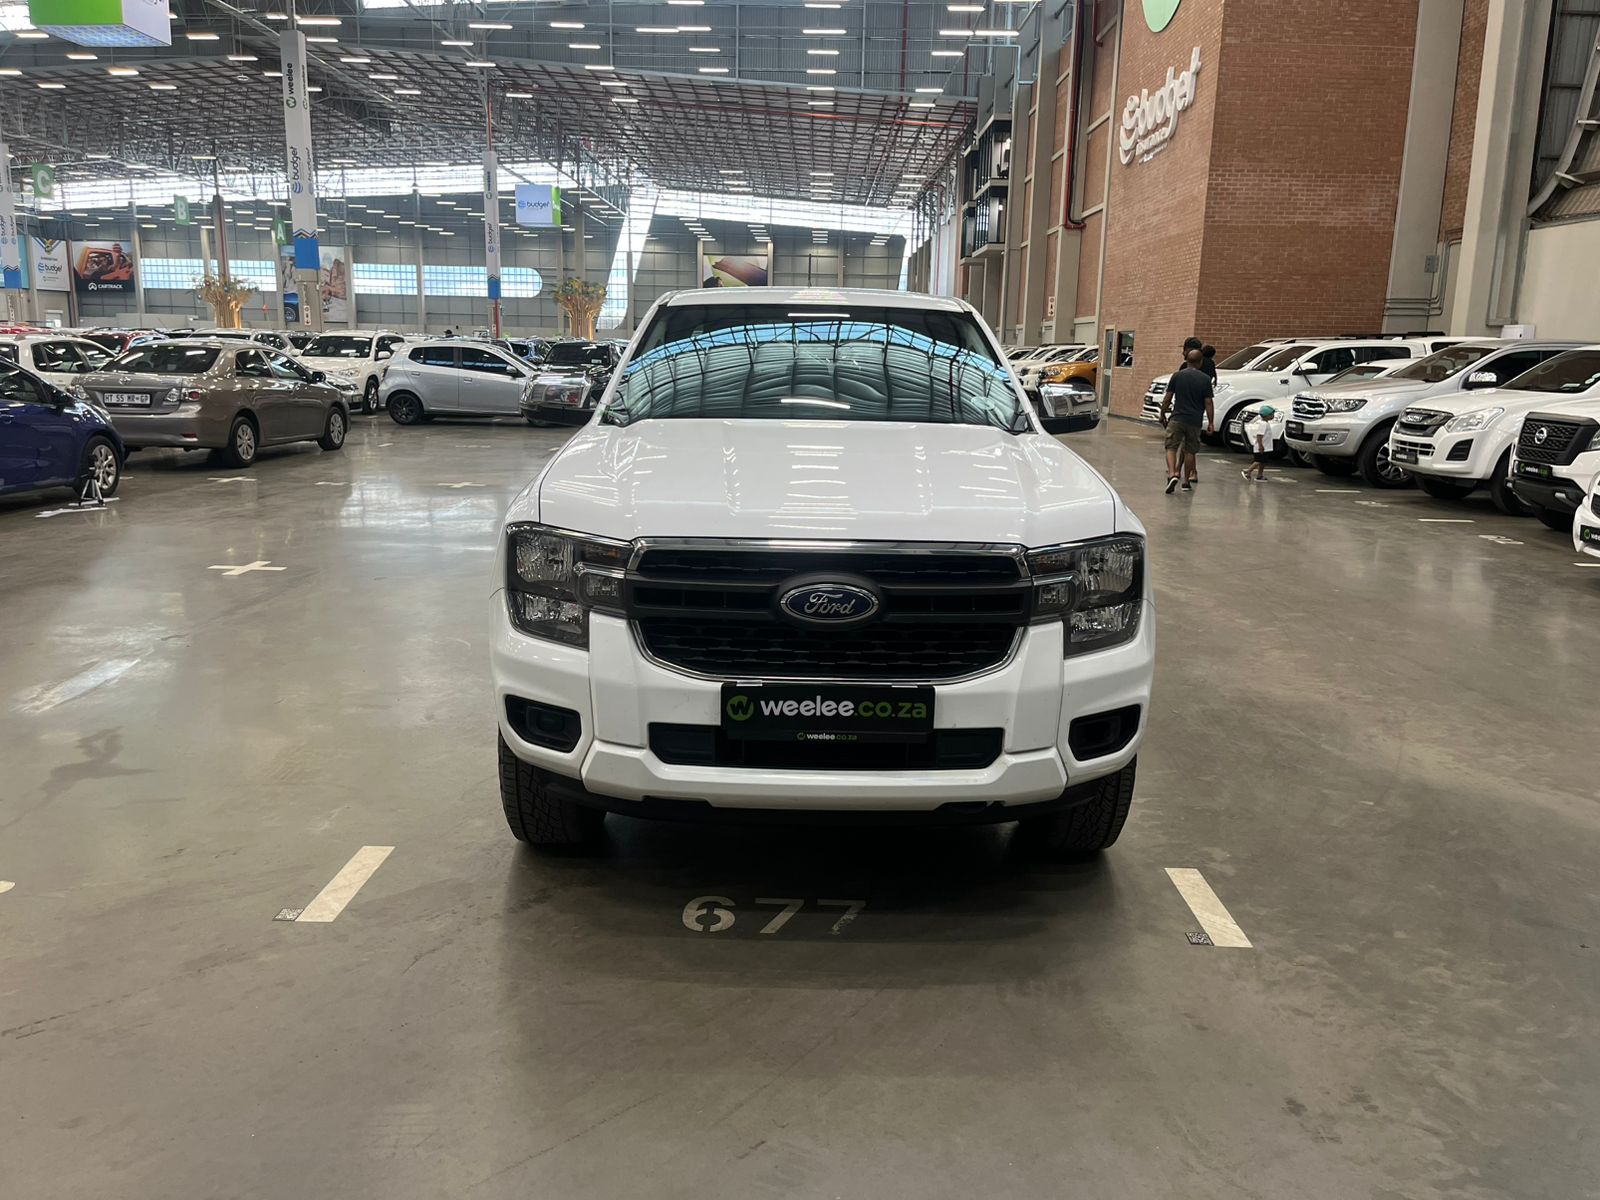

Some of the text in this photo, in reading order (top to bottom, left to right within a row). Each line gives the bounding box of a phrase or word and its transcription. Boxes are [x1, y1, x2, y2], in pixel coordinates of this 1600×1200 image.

[286, 62, 295, 95] weelee
[1138, 46, 1201, 140] budget
[289, 146, 301, 181] budget
[37, 169, 52, 194] C
[178, 202, 186, 220] B
[526, 200, 550, 211] budget
[276, 223, 285, 241] A
[44, 262, 63, 275] budget
[803, 592, 856, 614] Ford
[760, 695, 927, 719] weelee.co.za
[806, 732, 858, 741] weelee.co.za
[682, 895, 867, 934] 677
